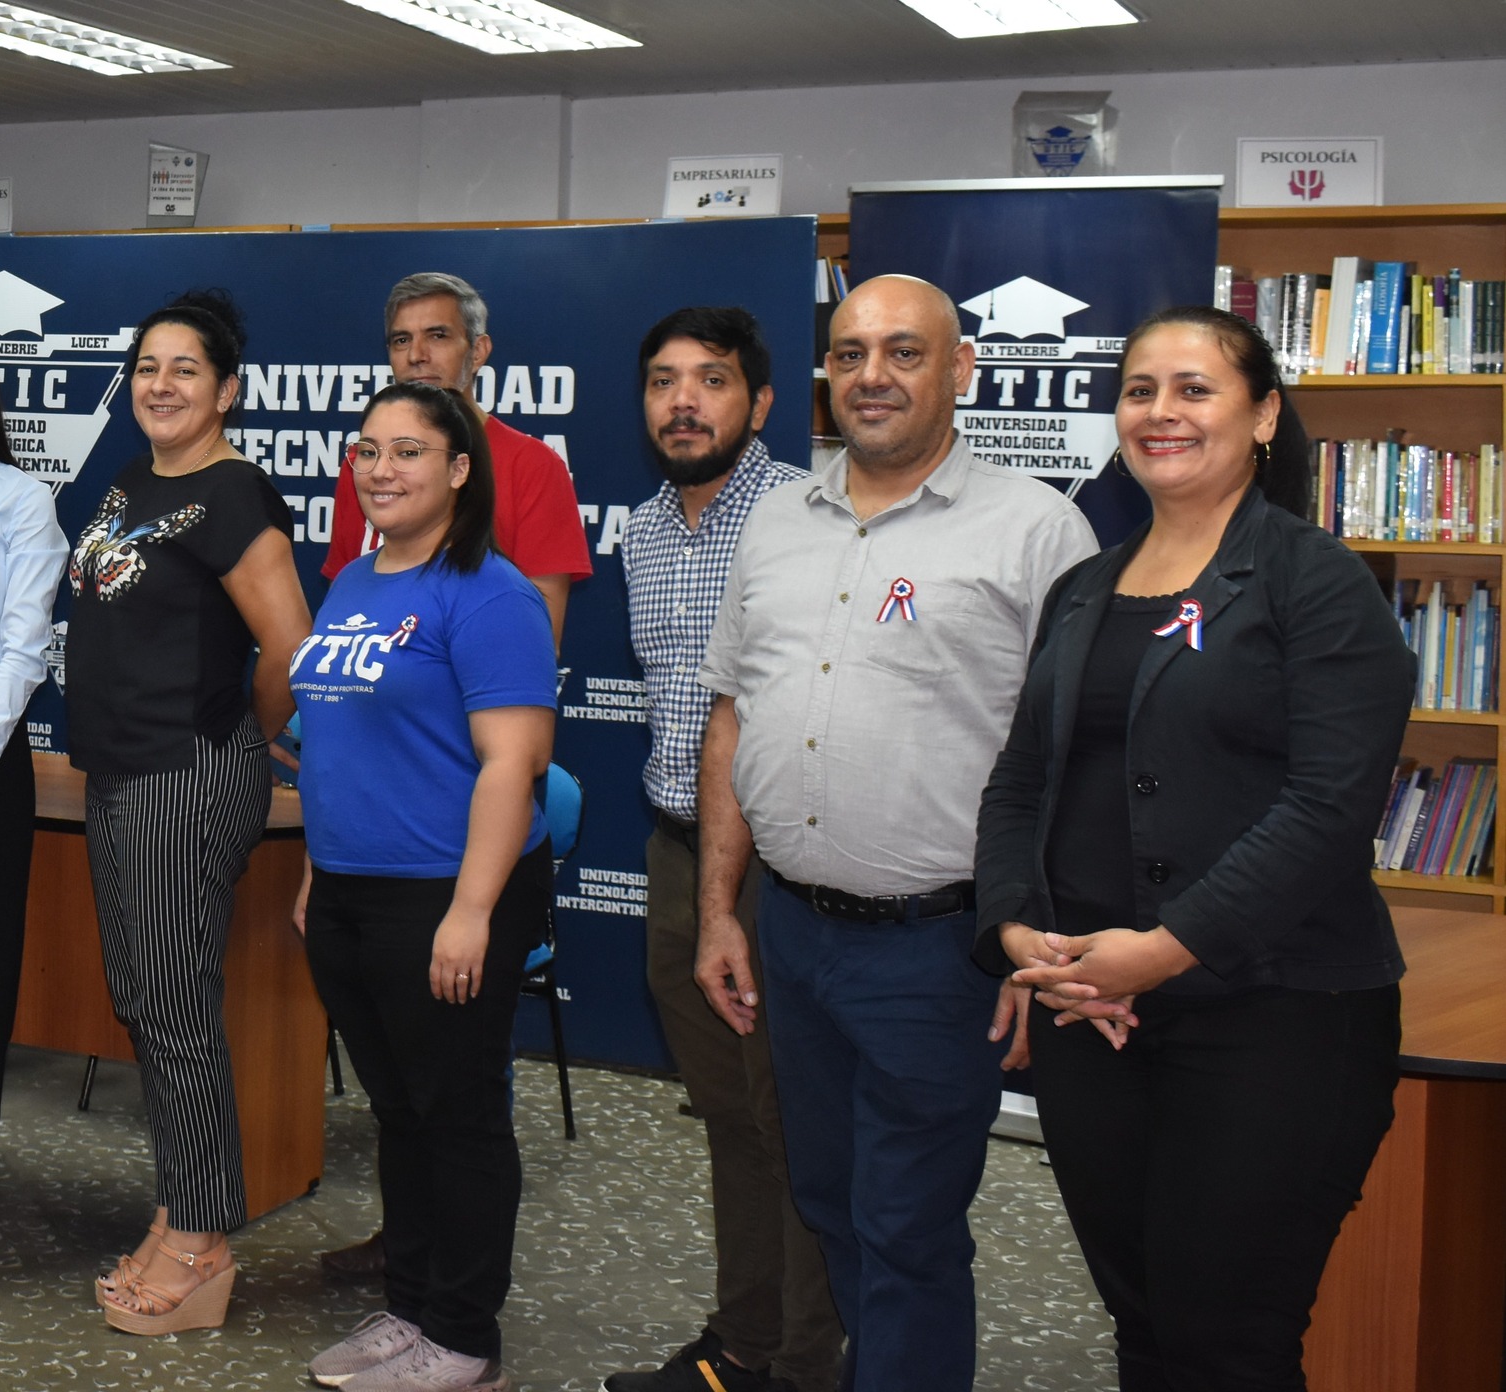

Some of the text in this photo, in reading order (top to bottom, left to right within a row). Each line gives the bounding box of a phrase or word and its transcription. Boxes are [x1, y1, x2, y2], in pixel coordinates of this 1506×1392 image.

[1260, 149, 1357, 163] PSICOLOGÍA
[673, 168, 777, 181] EMPRESARIALES
[71, 336, 110, 349] LUCET
[981, 339, 1127, 357] IN TENEBRIS LUC
[964, 416, 1067, 432] UNIVERSIDAD
[963, 432, 1066, 450] TECNOLÓGICA
[973, 453, 1093, 470] CONTINENTAL
[289, 634, 392, 682] UTIC
[586, 677, 647, 692] UNIVERSI
[310, 693, 322, 701] EST
[563, 706, 646, 723] INTERCONTI
[579, 867, 649, 886] UNIVERSID
[556, 895, 648, 917] INTERCONTIN
